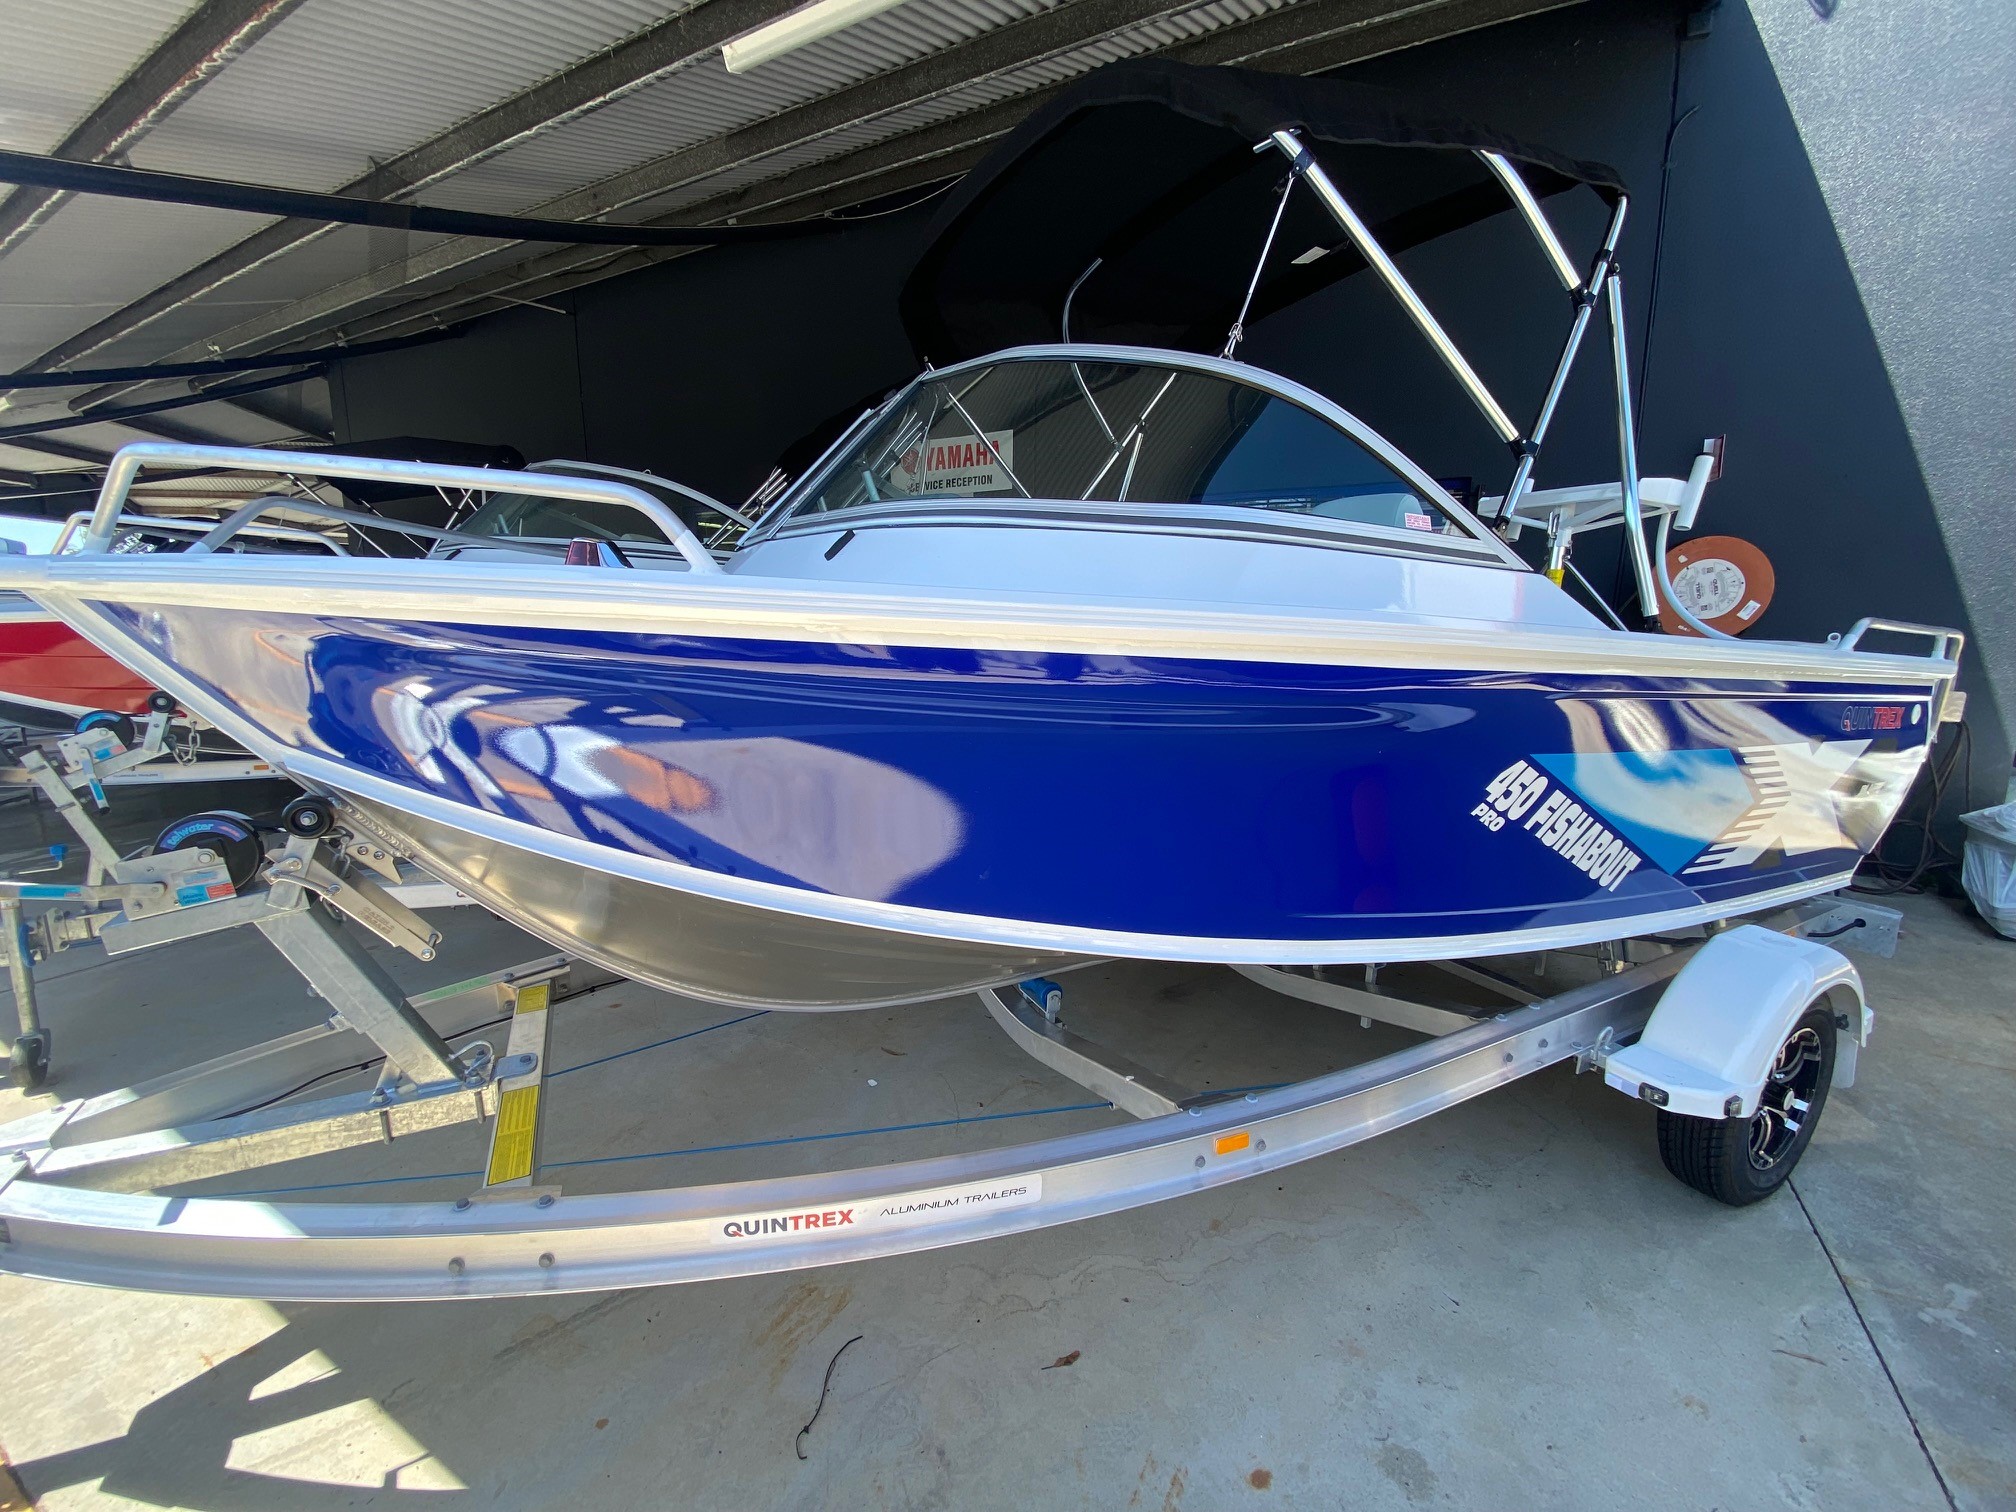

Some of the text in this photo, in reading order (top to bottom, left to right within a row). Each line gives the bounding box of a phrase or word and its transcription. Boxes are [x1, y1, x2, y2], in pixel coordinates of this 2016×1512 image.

[926, 440, 1000, 472] YAMAHA
[909, 474, 993, 493] SEVICE RECEPTION
[1840, 705, 1906, 732] QUINTREX
[1470, 802, 1506, 832] PRO
[1485, 759, 1642, 893] 450 FISHABOUT
[723, 1186, 1027, 1239] QUINTREX ALUMINIUM TRAILERS
